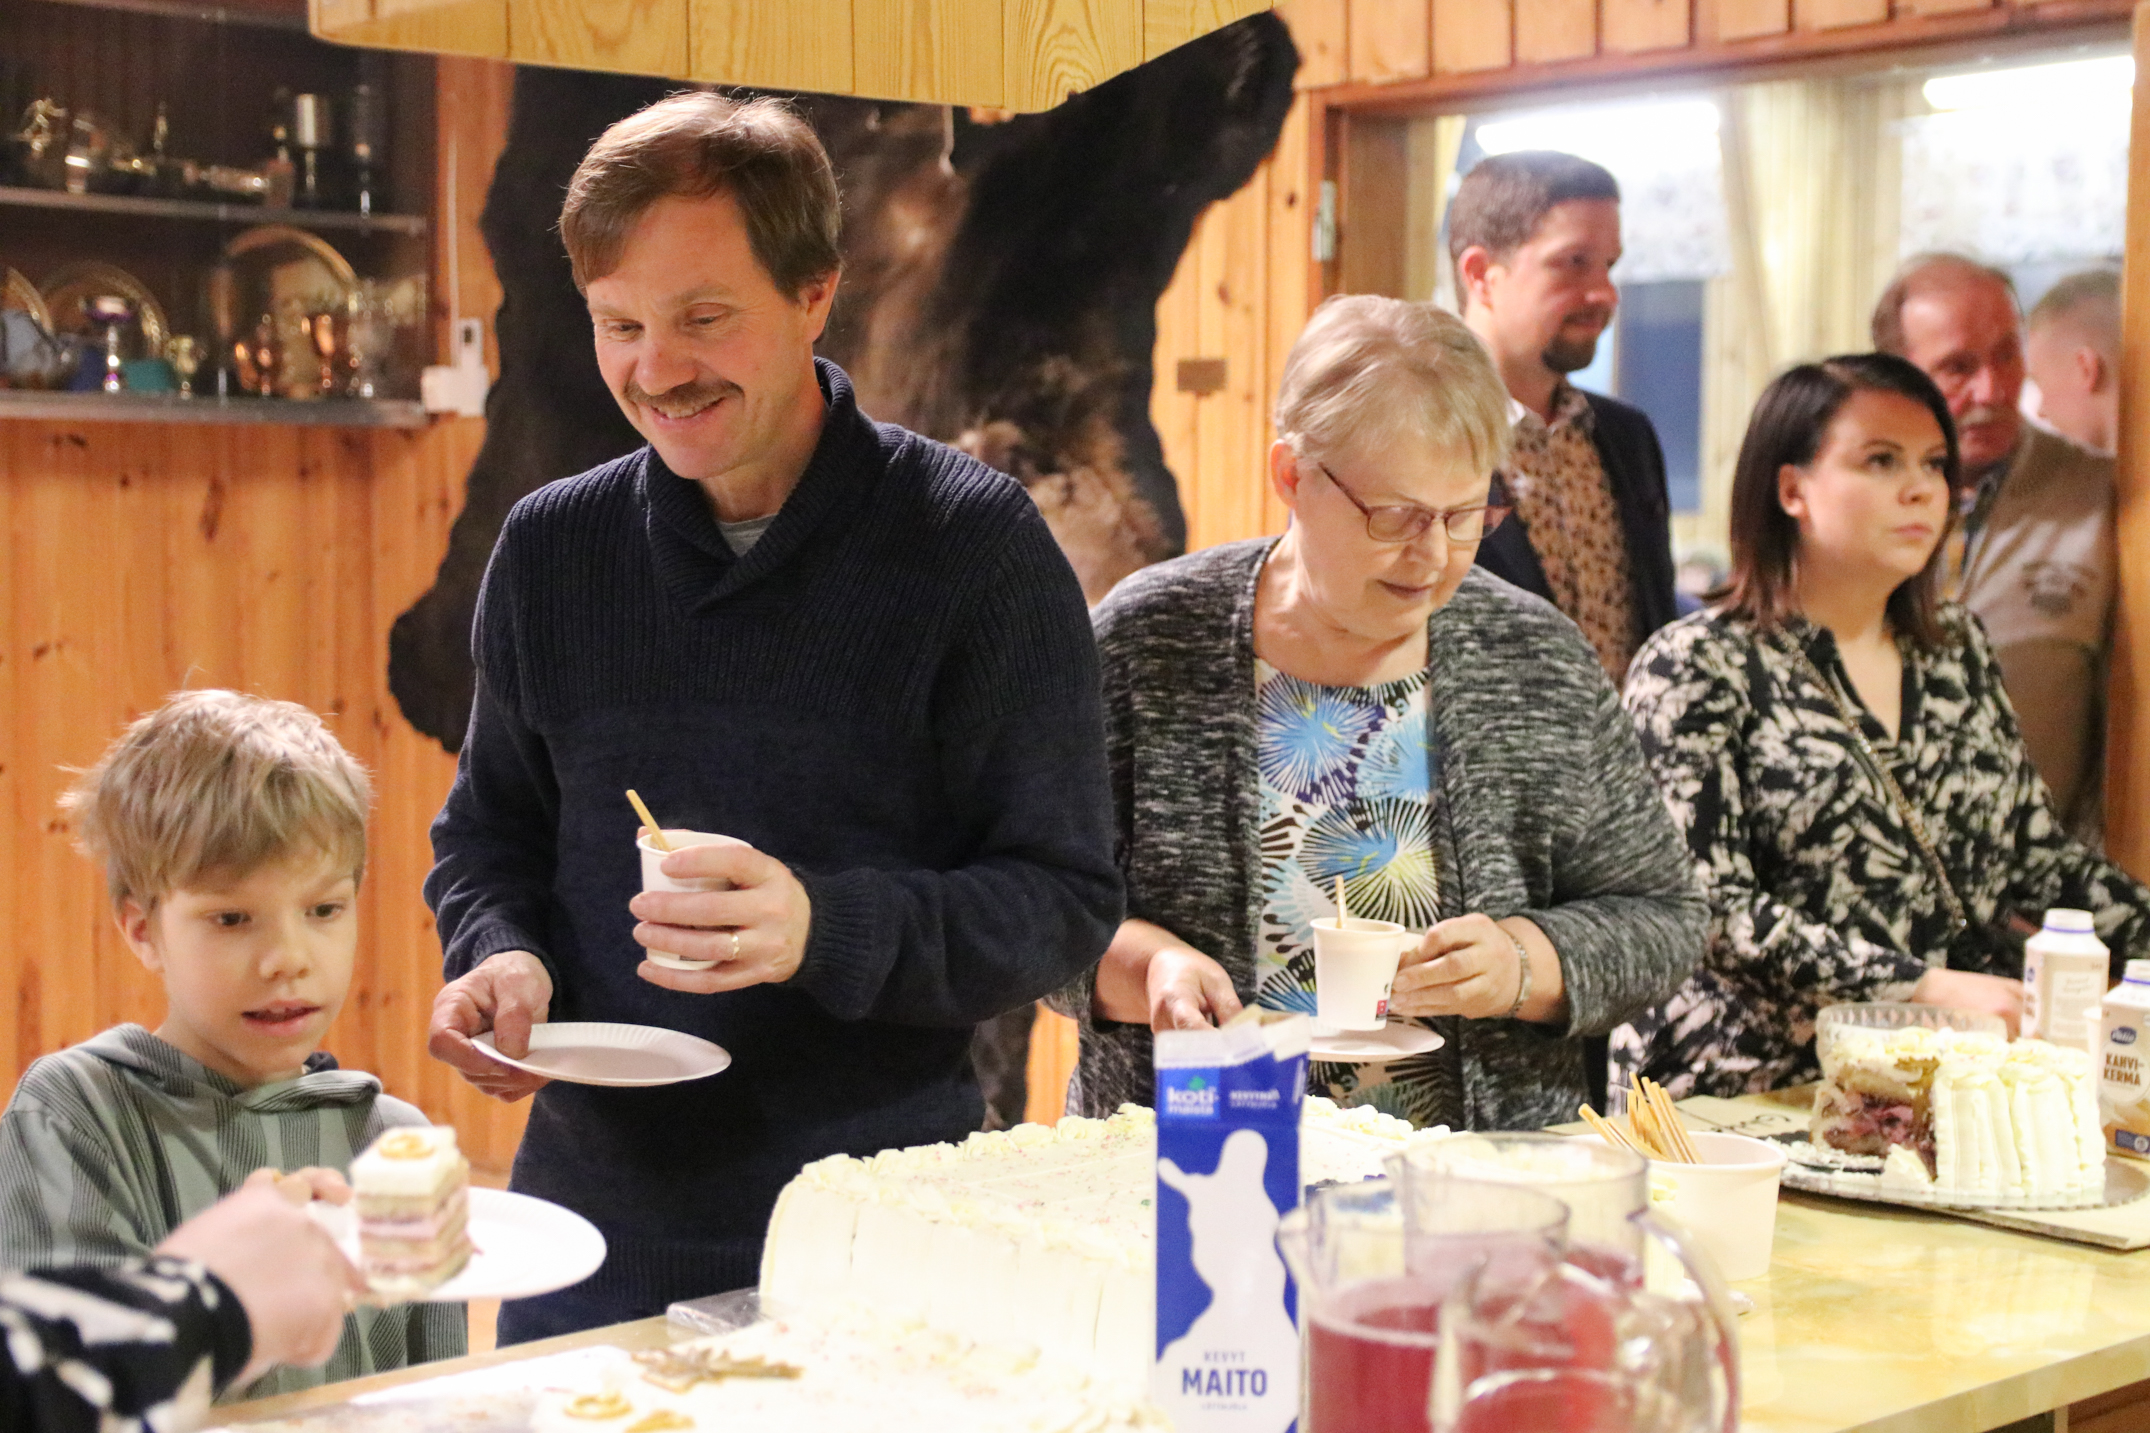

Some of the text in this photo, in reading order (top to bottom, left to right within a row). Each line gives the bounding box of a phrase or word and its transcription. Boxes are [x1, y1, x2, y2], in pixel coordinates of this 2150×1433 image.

[2104, 1068, 2140, 1086] KERMA
[1166, 1086, 1217, 1104] koti
[1204, 1351, 1245, 1362] KEVYT
[1182, 1367, 1267, 1397] MAITO
